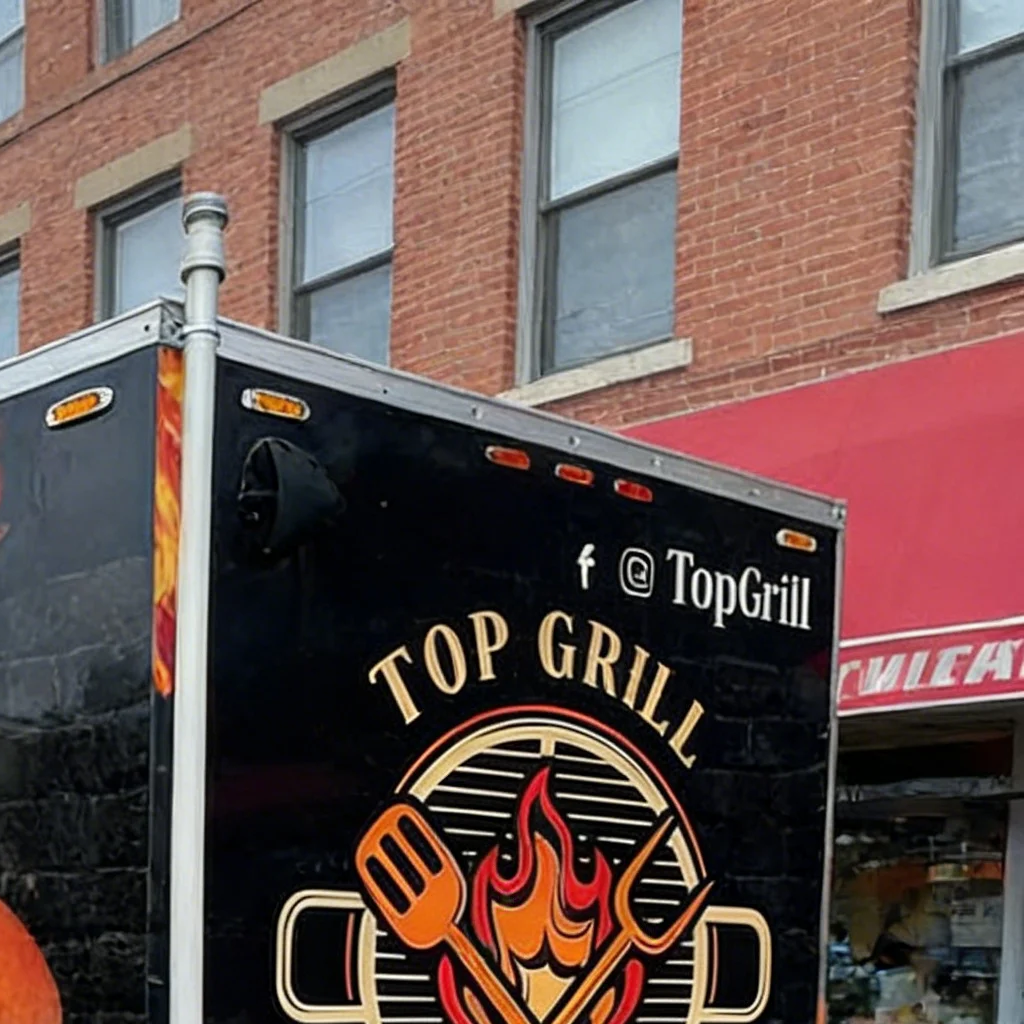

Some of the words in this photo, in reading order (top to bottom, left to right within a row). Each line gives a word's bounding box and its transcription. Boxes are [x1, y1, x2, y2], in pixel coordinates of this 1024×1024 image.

[666, 548, 812, 630] TopGrill
[368, 610, 509, 725] TOP
[538, 610, 705, 769] GRILL
